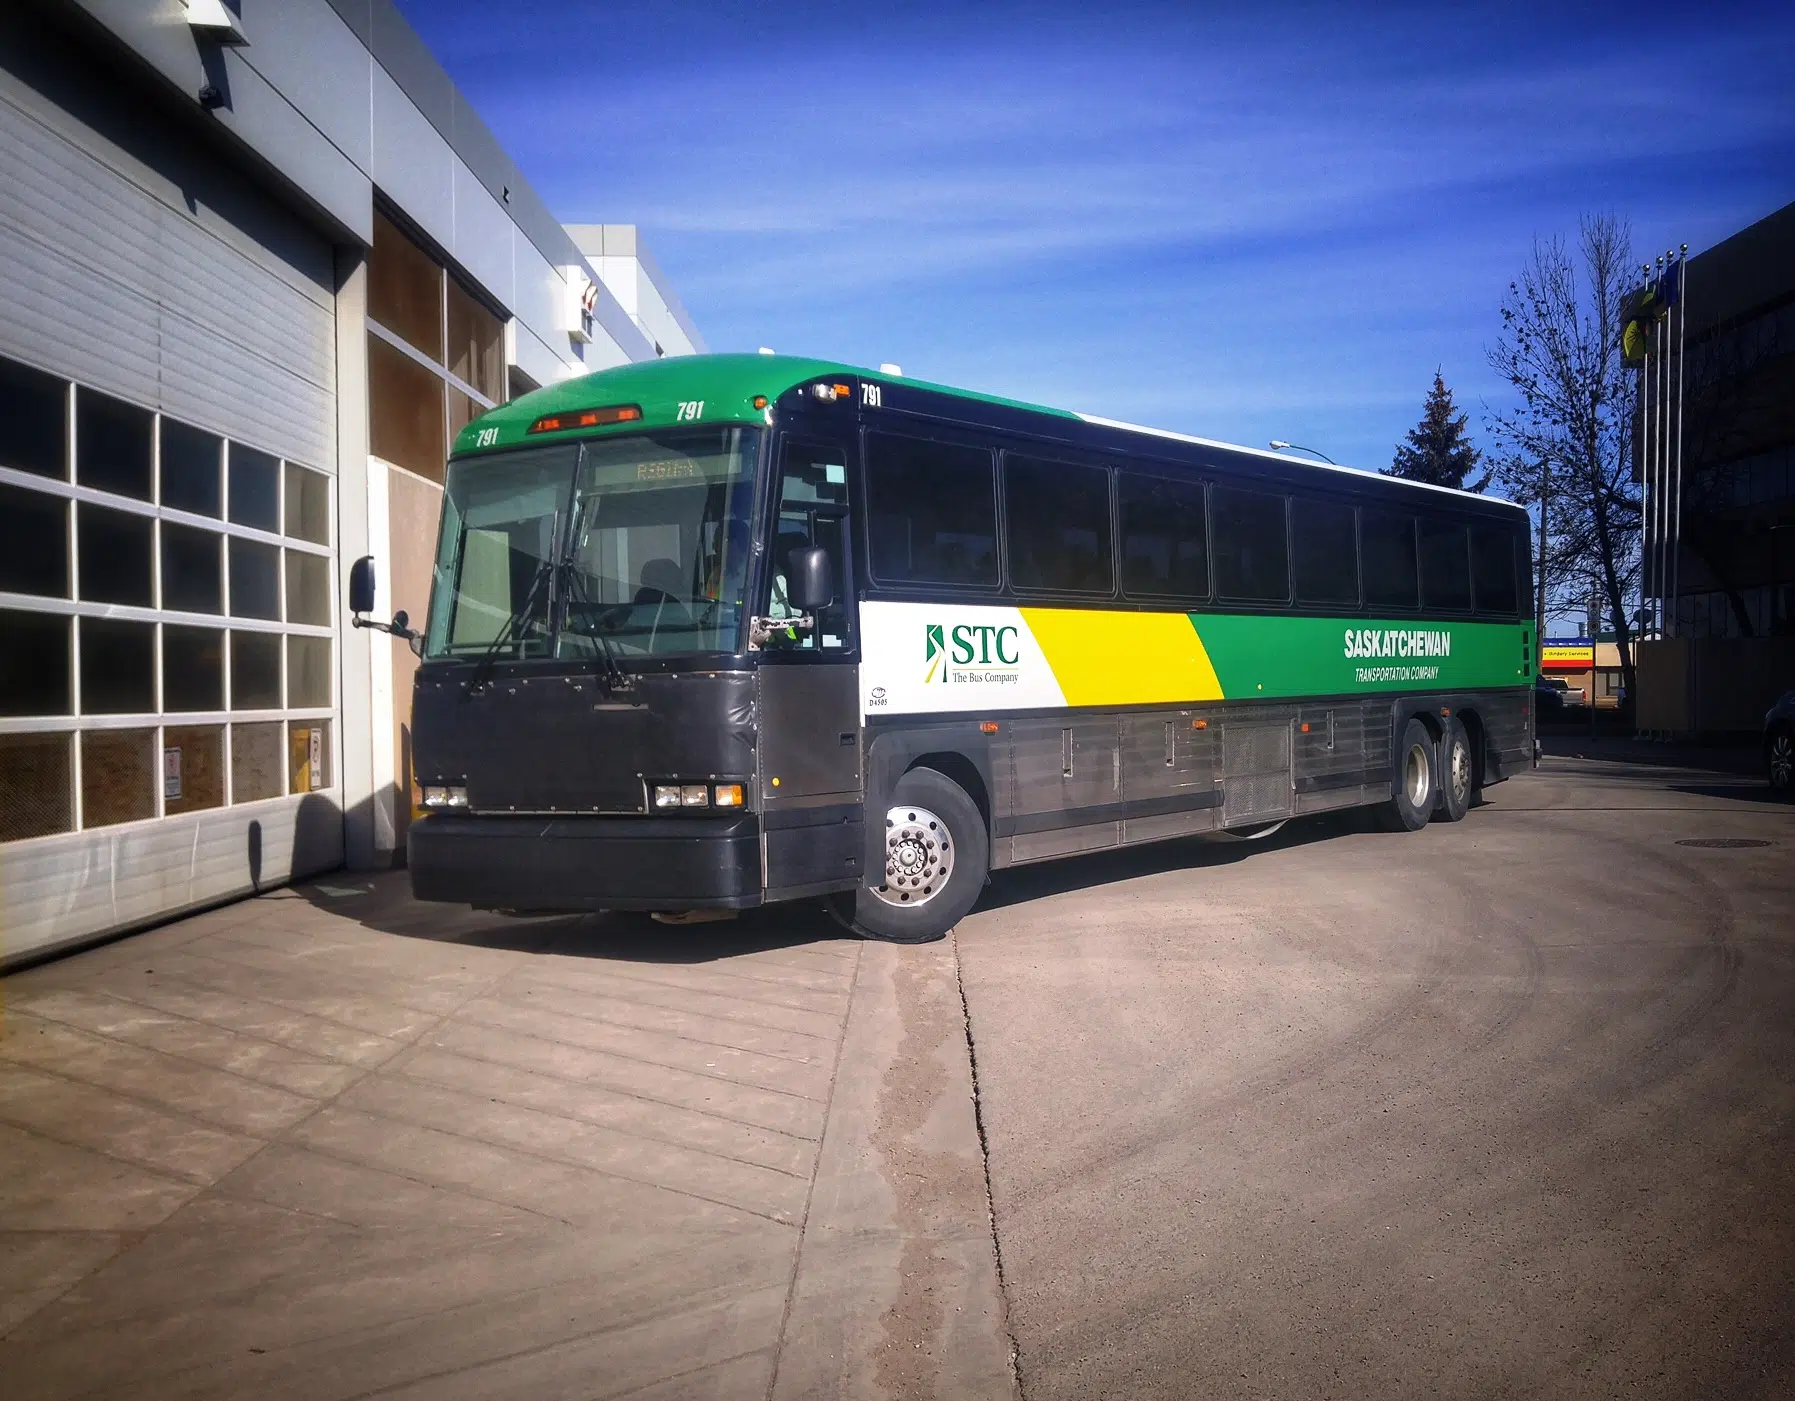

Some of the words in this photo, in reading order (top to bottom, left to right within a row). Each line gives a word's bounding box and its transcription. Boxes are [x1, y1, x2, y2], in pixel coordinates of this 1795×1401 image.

[861, 383, 881, 406] 791
[676, 401, 705, 421] 791
[476, 427, 499, 447] 791
[951, 625, 1019, 664] STC
[1344, 629, 1451, 658] SASKATCHEWAN
[952, 672, 968, 683] The
[969, 672, 983, 683] Bus
[984, 673, 1019, 684] Company
[1355, 667, 1410, 682] TRANSPORTATION
[1410, 666, 1439, 680] COMPANY
